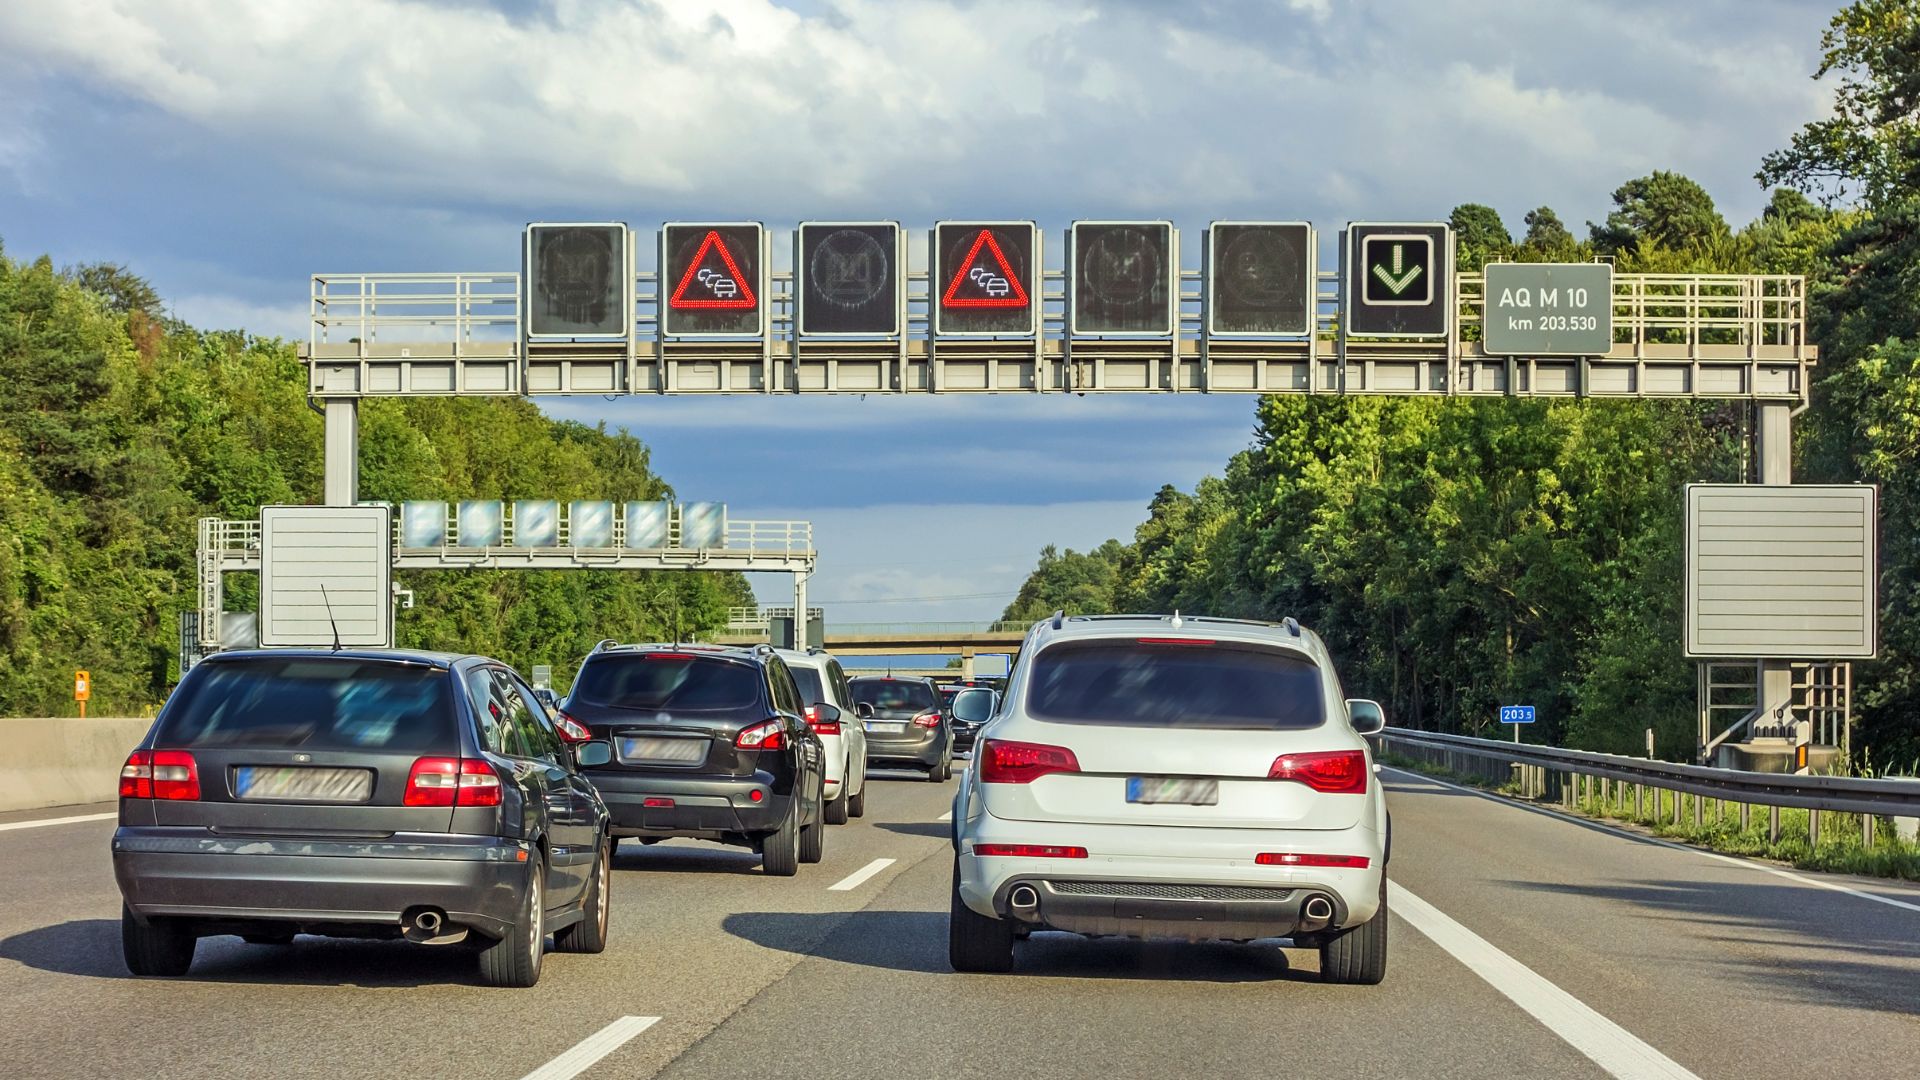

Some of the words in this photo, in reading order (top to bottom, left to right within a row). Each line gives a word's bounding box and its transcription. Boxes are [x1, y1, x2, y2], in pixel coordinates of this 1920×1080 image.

[1499, 288, 1531, 307] AQ
[1540, 288, 1557, 307] M
[1567, 288, 1588, 307] 10
[1509, 316, 1533, 330] km
